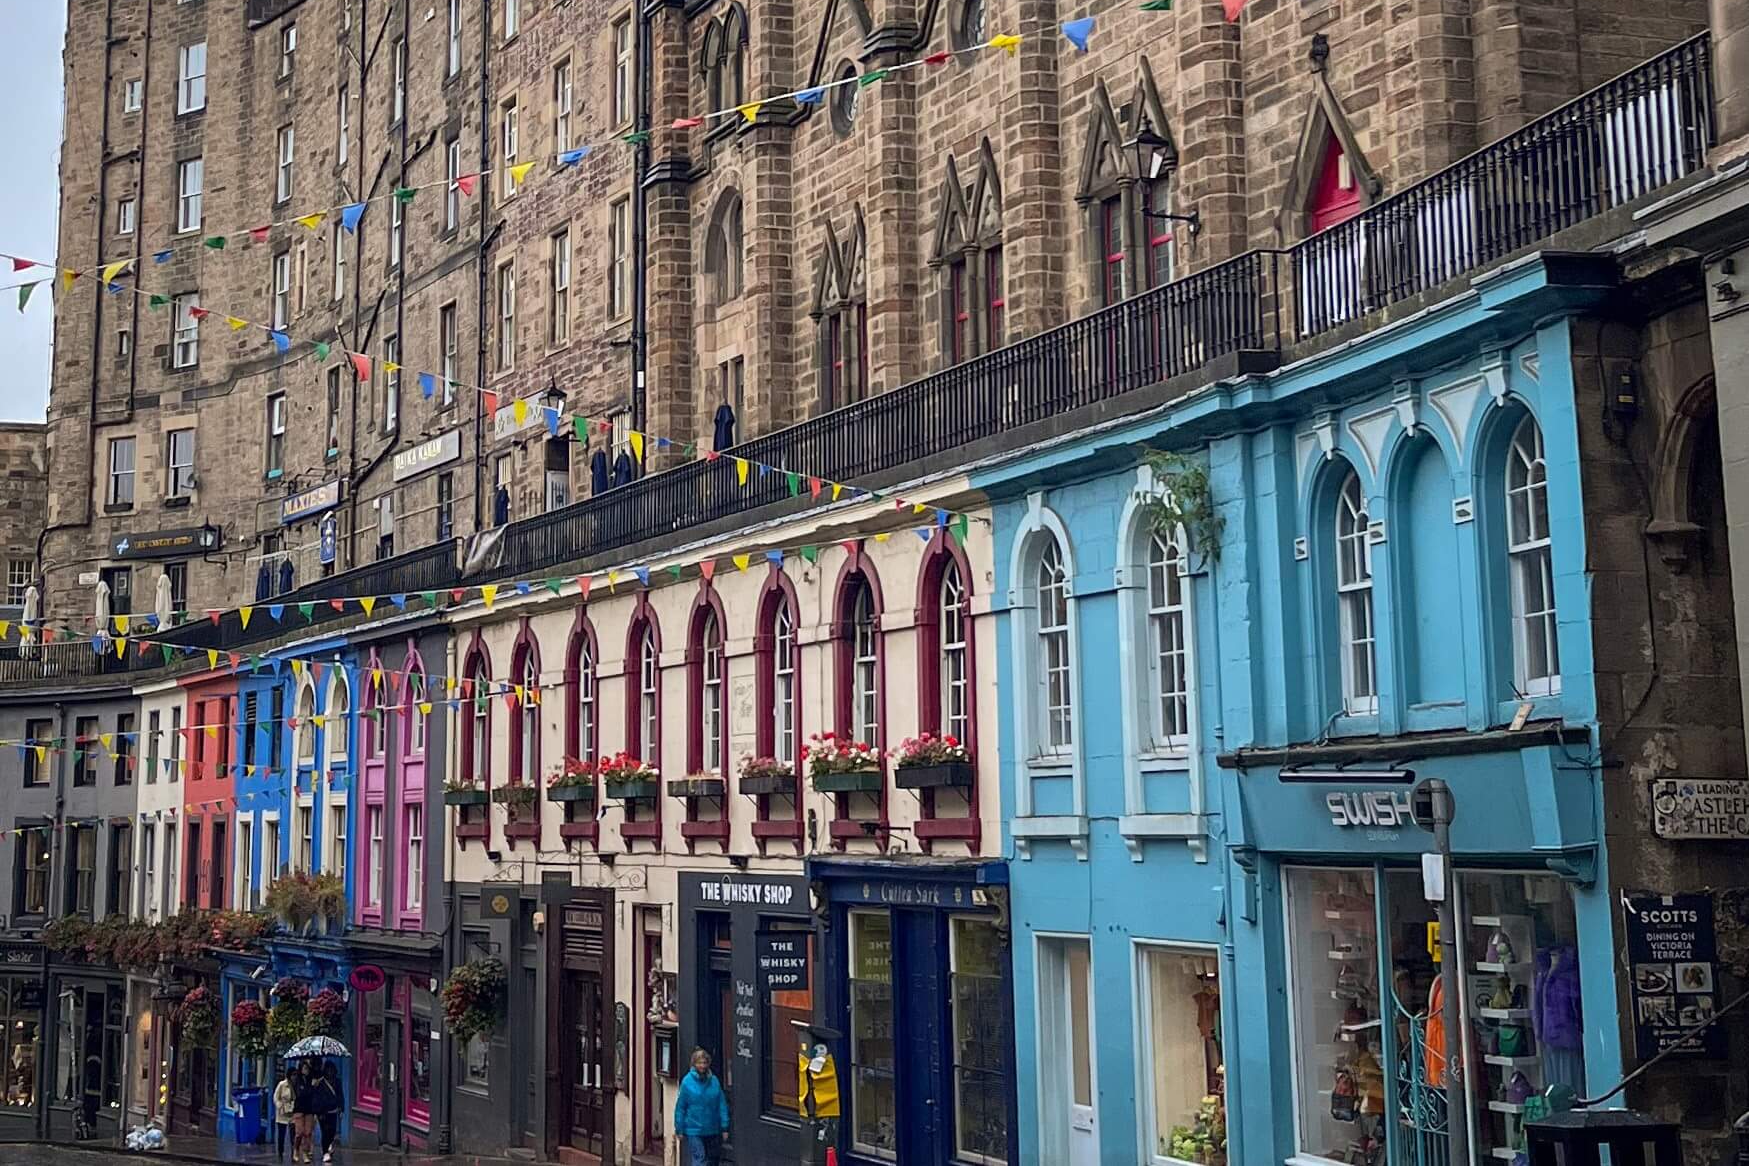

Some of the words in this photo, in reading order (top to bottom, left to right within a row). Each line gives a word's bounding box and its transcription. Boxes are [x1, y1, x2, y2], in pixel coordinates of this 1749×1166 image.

[1697, 784, 1741, 795] LEADING
[1326, 791, 1417, 826] SWISH
[1697, 818, 1729, 835] THE
[701, 882, 721, 901] THE
[721, 882, 762, 904] WHISKY
[764, 885, 792, 905] SHOP
[1640, 911, 1698, 924] SCOTTS
[1646, 933, 1680, 942] DINING
[1681, 933, 1696, 941] ON
[771, 942, 794, 951] THE
[1651, 942, 1693, 950] VICTORIA
[1652, 951, 1693, 960] TERRACE
[760, 958, 806, 968] WHISKY
[768, 975, 798, 985] SHOP
